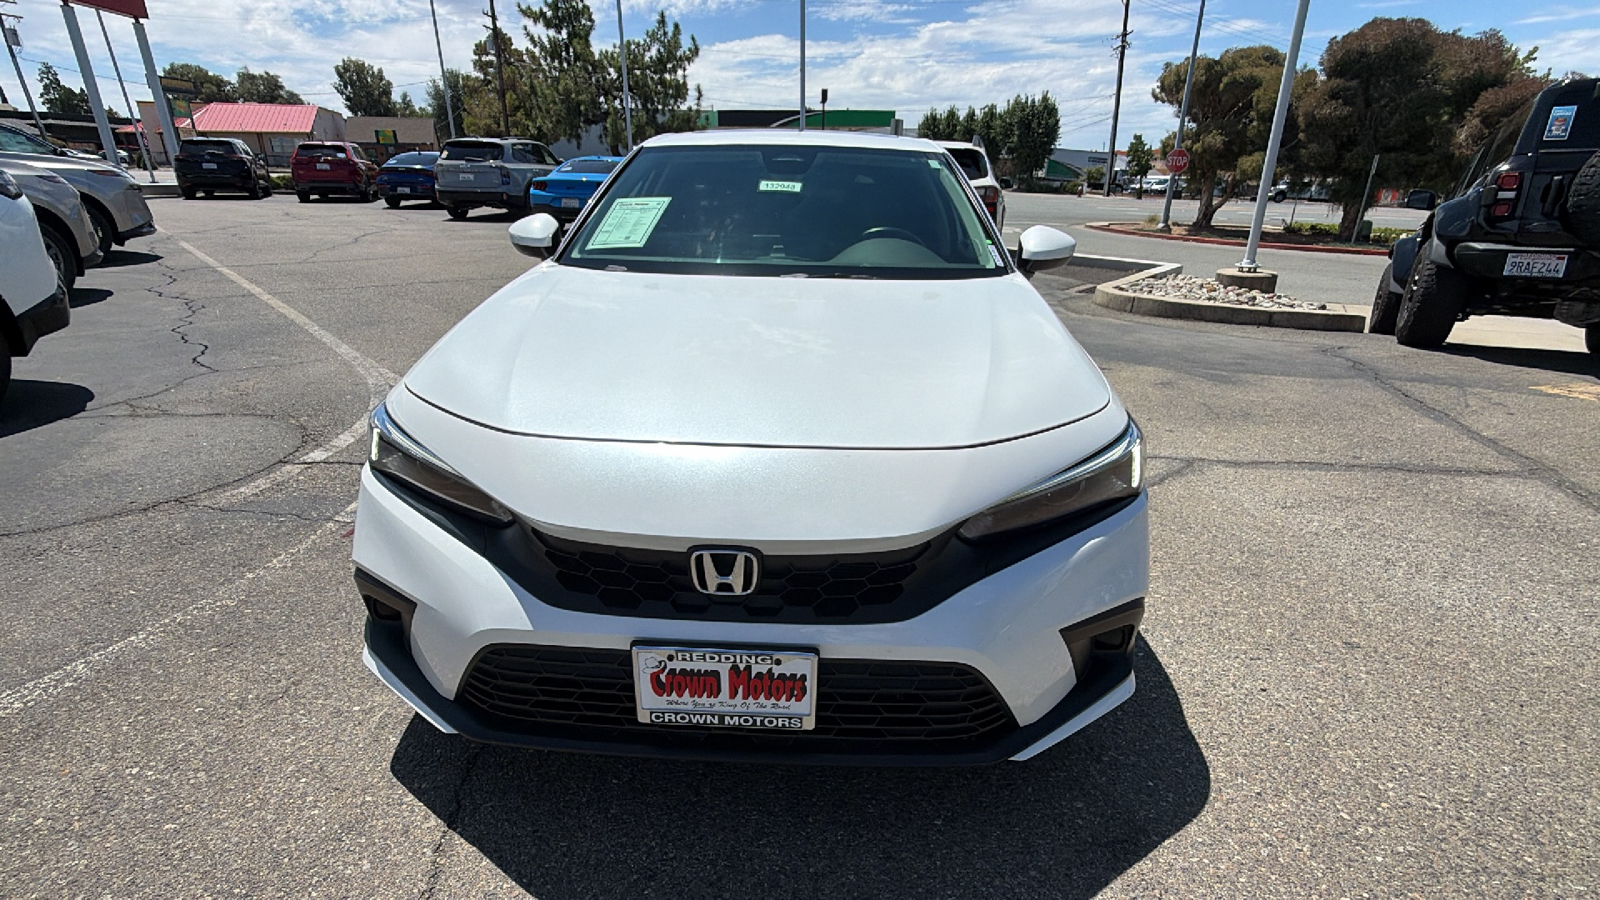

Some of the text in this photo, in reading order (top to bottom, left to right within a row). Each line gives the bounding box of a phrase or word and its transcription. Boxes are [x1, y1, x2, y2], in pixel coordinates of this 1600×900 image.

[1167, 156, 1188, 166] STOP
[1508, 261, 1560, 273] 9RAF244
[677, 652, 772, 664] REDDING
[650, 662, 807, 702] Crown Motors
[718, 701, 738, 709] King
[651, 712, 802, 728] CROWN MOTORS
